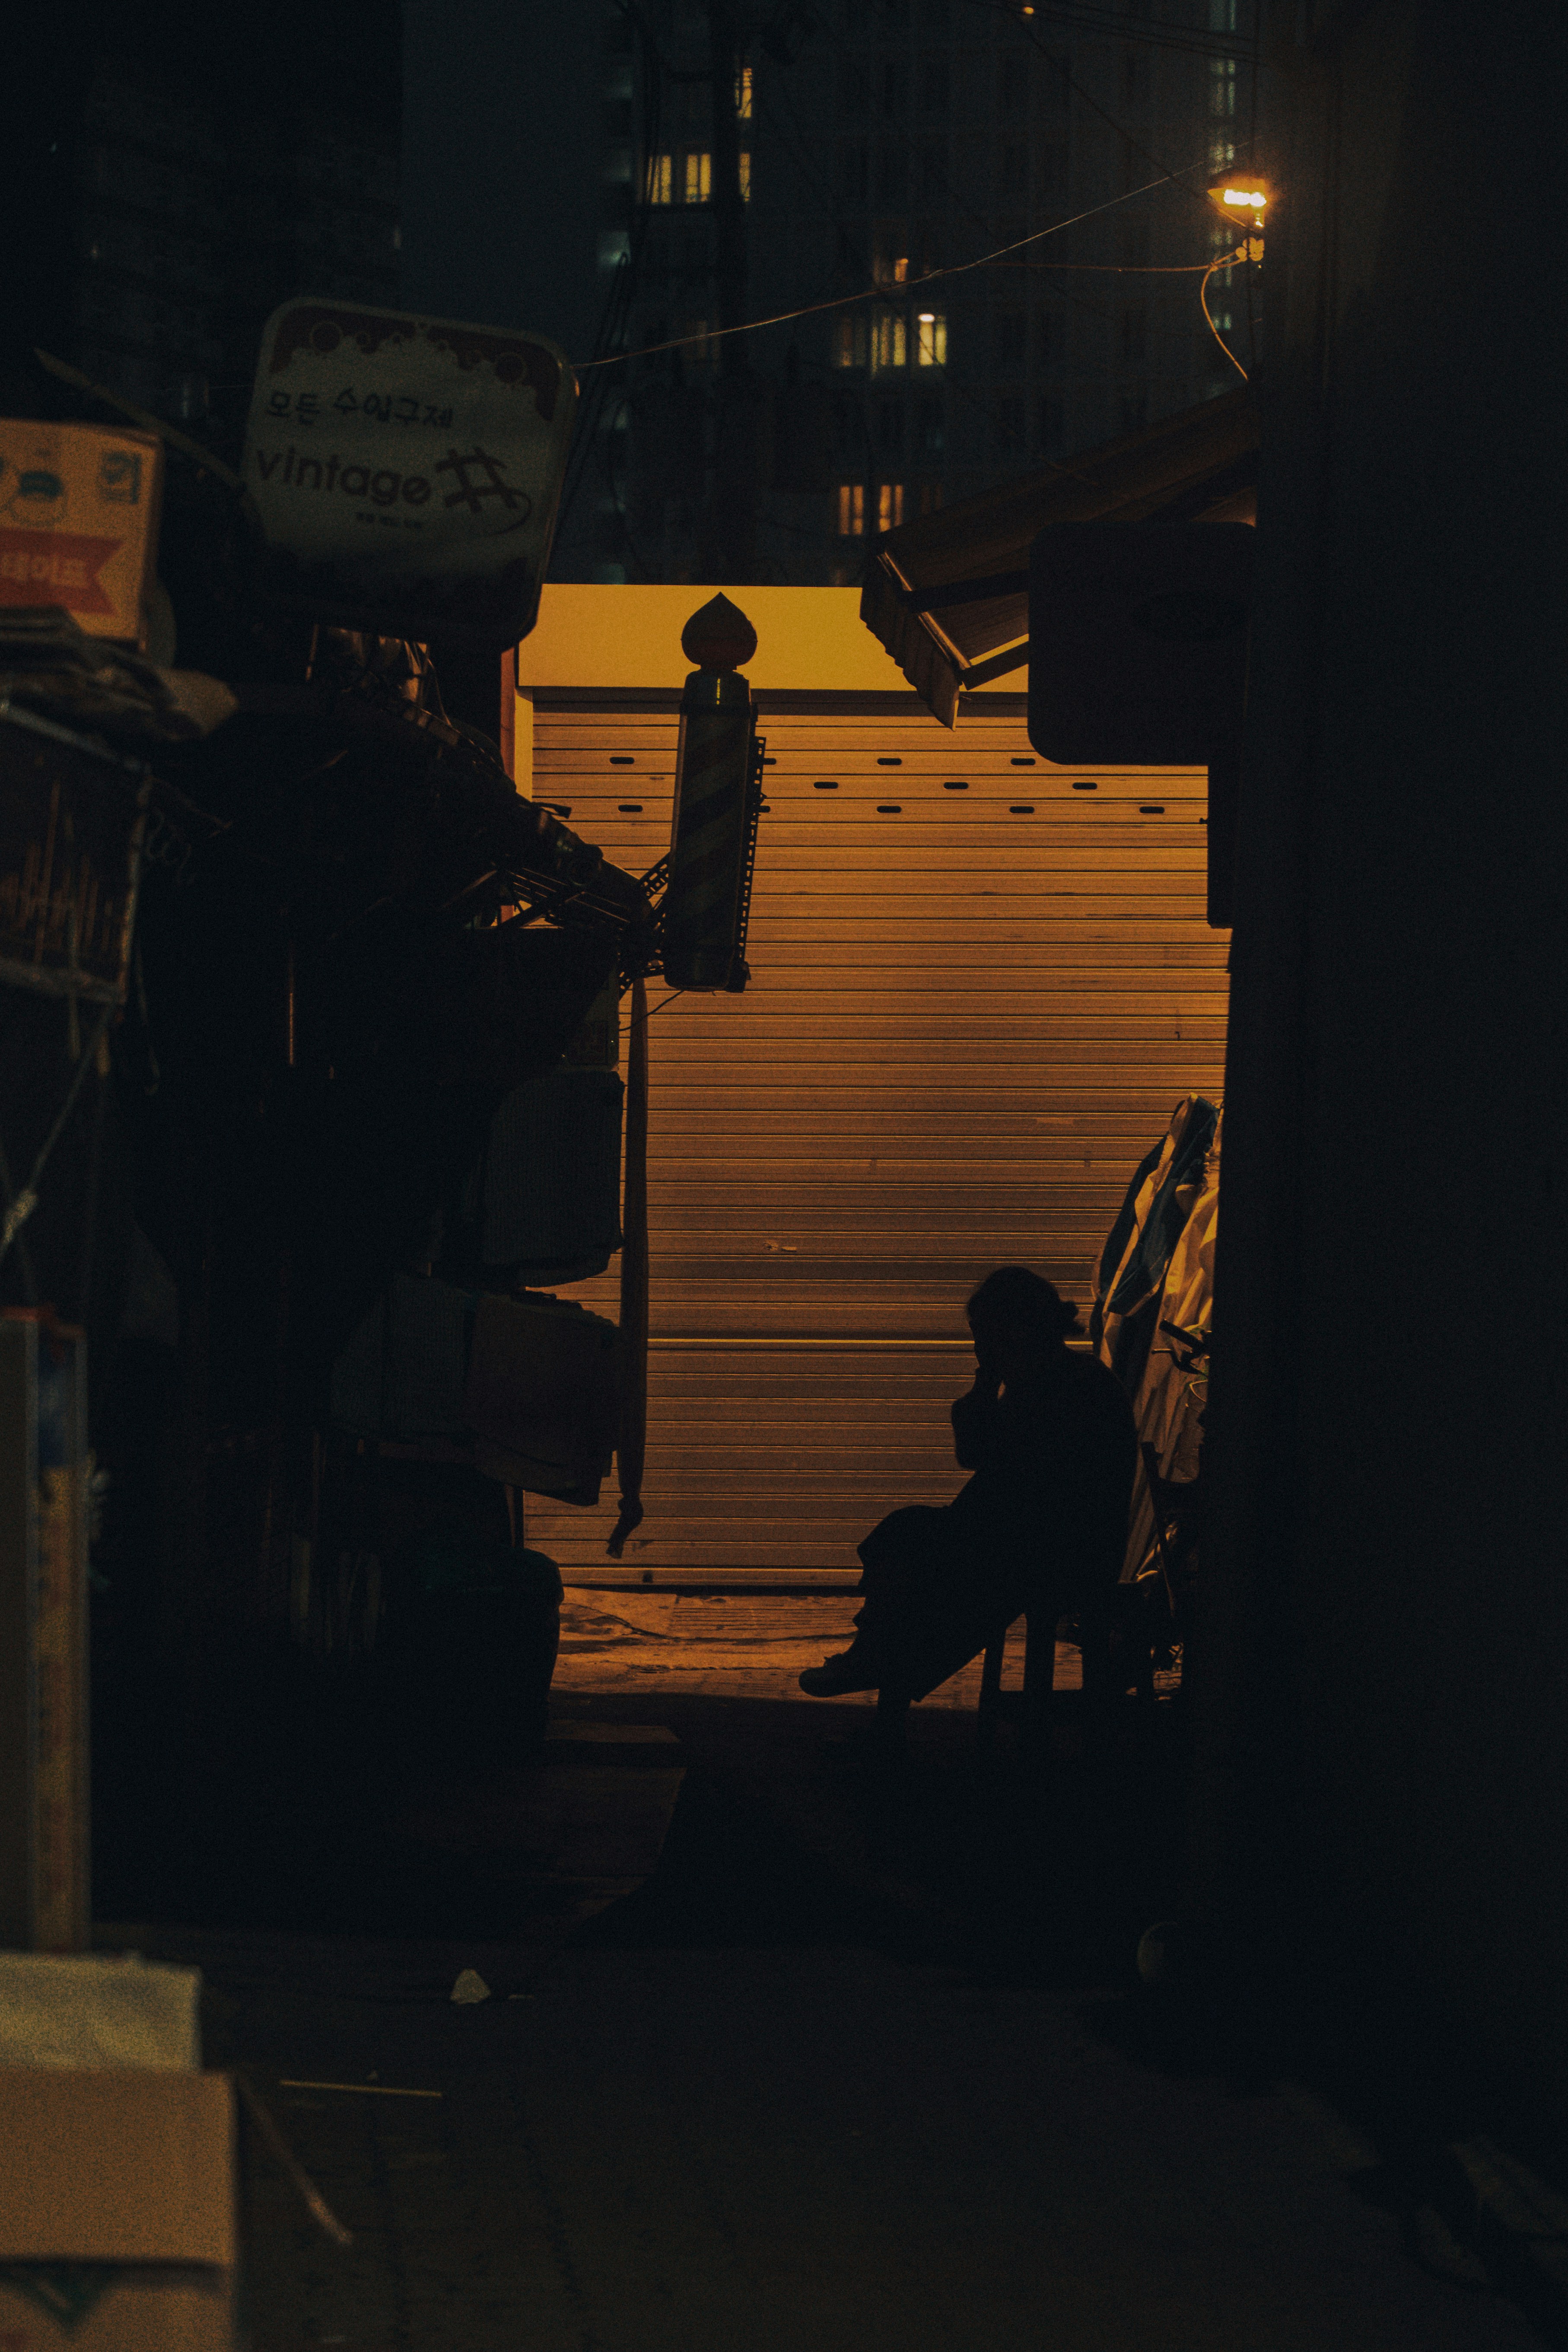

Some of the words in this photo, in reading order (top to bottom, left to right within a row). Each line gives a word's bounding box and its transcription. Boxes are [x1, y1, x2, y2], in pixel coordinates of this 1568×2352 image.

[266, 391, 321, 425] 모든
[334, 388, 453, 428] 수입구제
[257, 447, 431, 505] vintage
